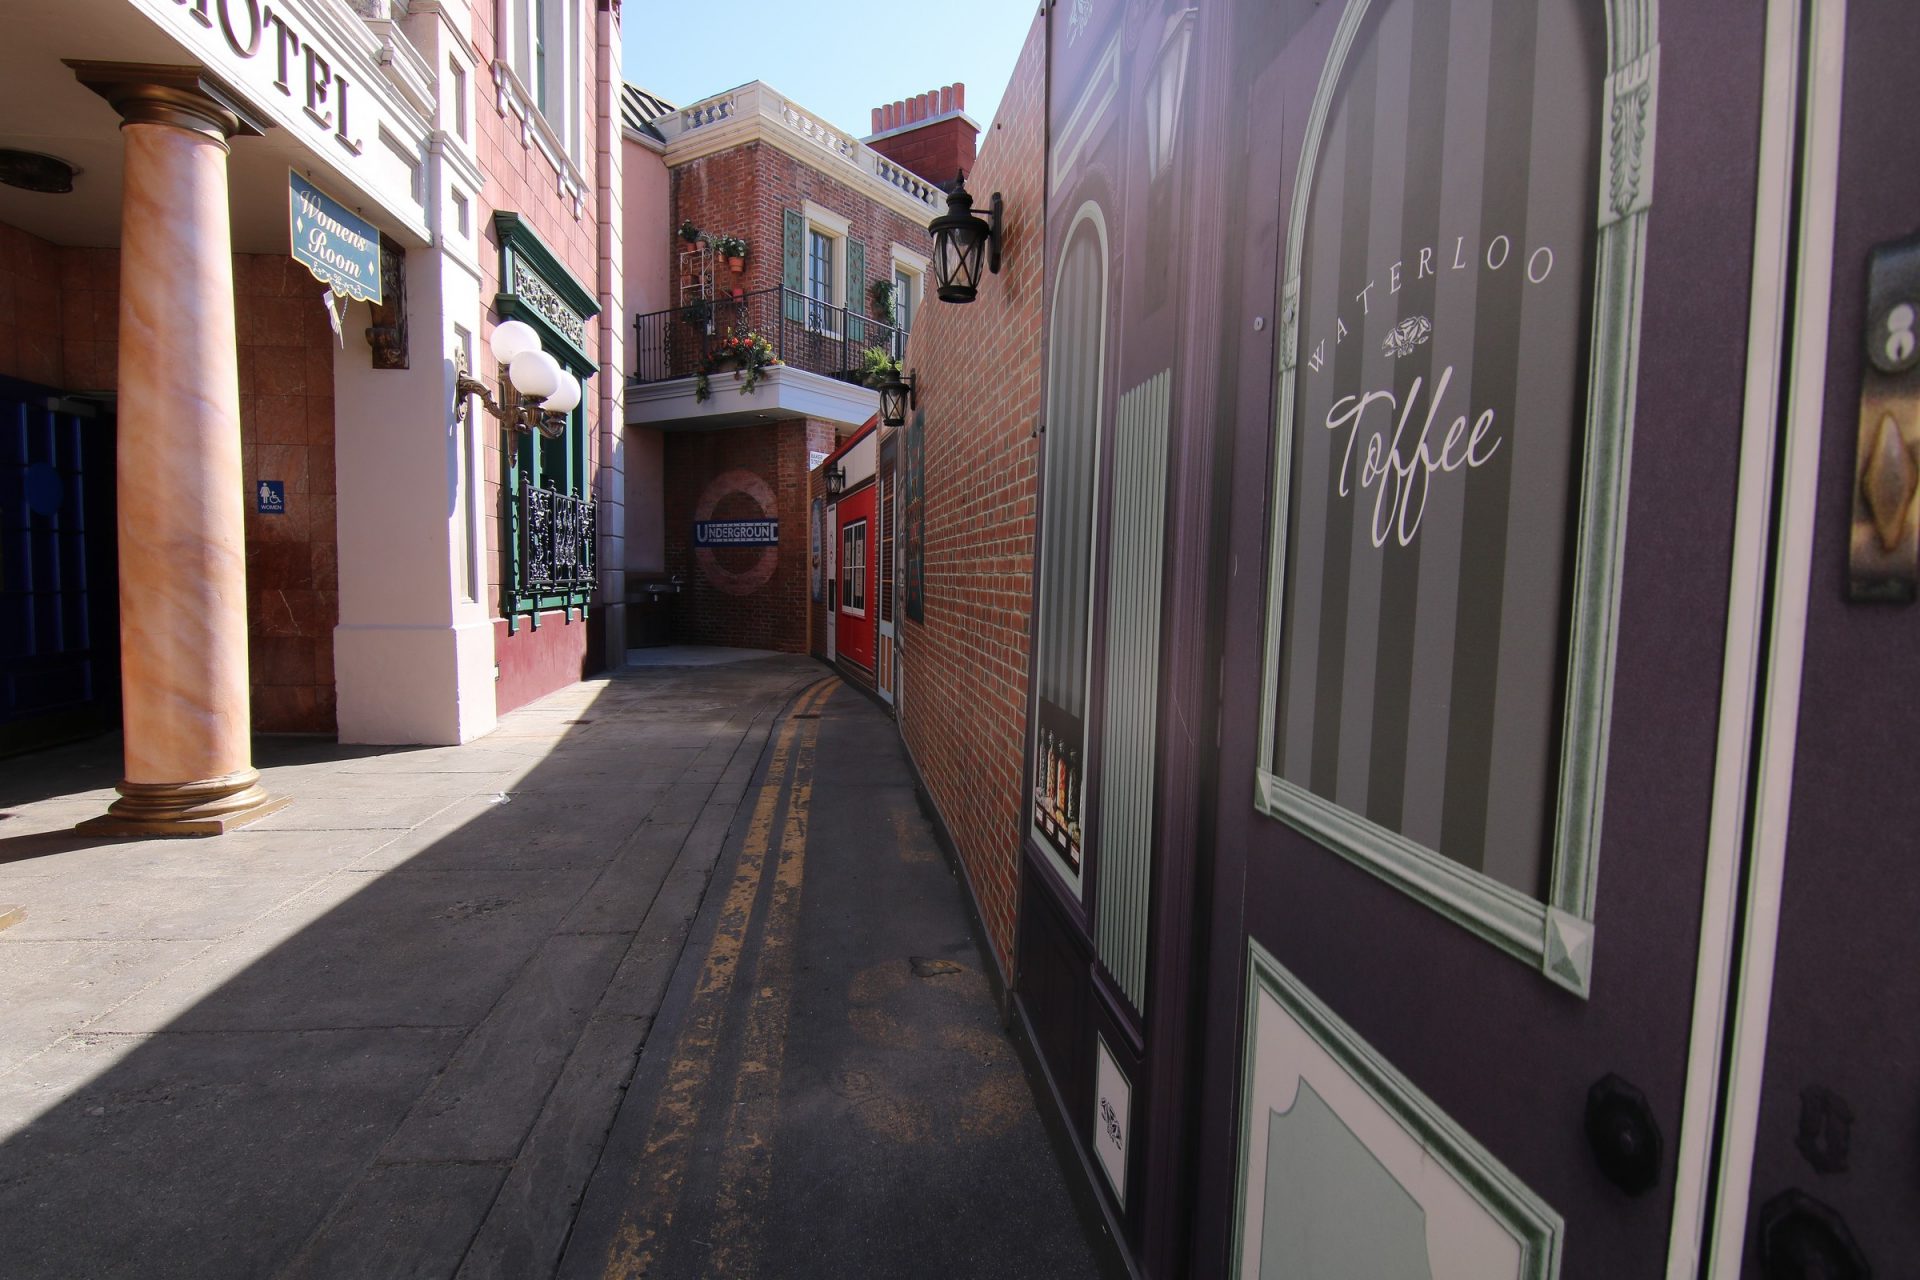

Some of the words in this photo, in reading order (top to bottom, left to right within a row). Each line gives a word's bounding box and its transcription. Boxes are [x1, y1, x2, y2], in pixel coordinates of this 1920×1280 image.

[171, 0, 363, 157] OTEL
[300, 190, 367, 252] Women's
[308, 227, 361, 278] Room
[1308, 235, 1553, 373] WATERLOO
[1325, 365, 1502, 548] Toffee
